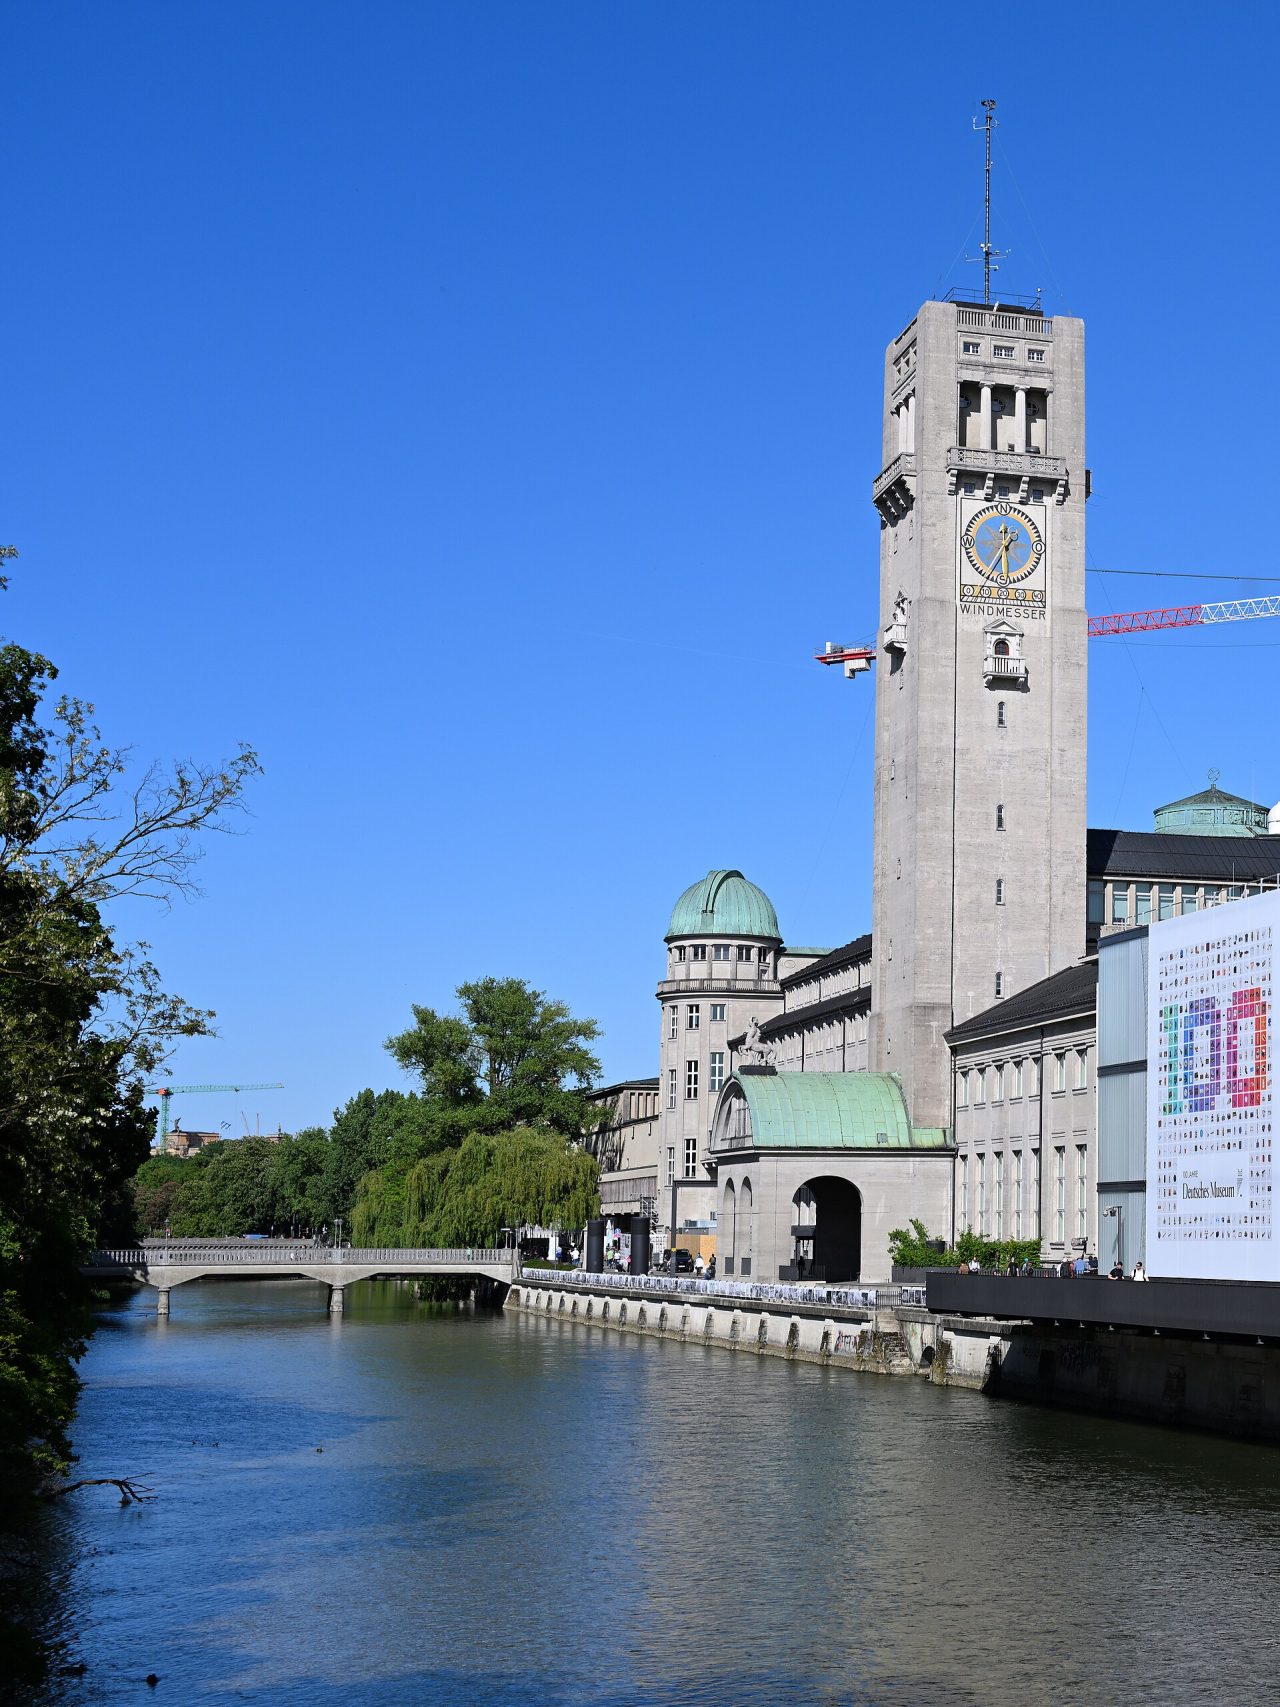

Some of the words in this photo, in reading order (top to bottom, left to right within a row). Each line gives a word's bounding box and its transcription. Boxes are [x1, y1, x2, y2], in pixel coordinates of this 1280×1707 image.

[1000, 504, 1008, 513] N
[962, 537, 974, 547] W
[1034, 542, 1043, 552] O
[999, 575, 1008, 585] S
[999, 589, 1008, 597] 20
[1016, 590, 1025, 598] 30
[960, 603, 1046, 620] WINDMESSER
[1182, 1180, 1210, 1199] Deutsches
[1210, 1181, 1235, 1198] Museum
